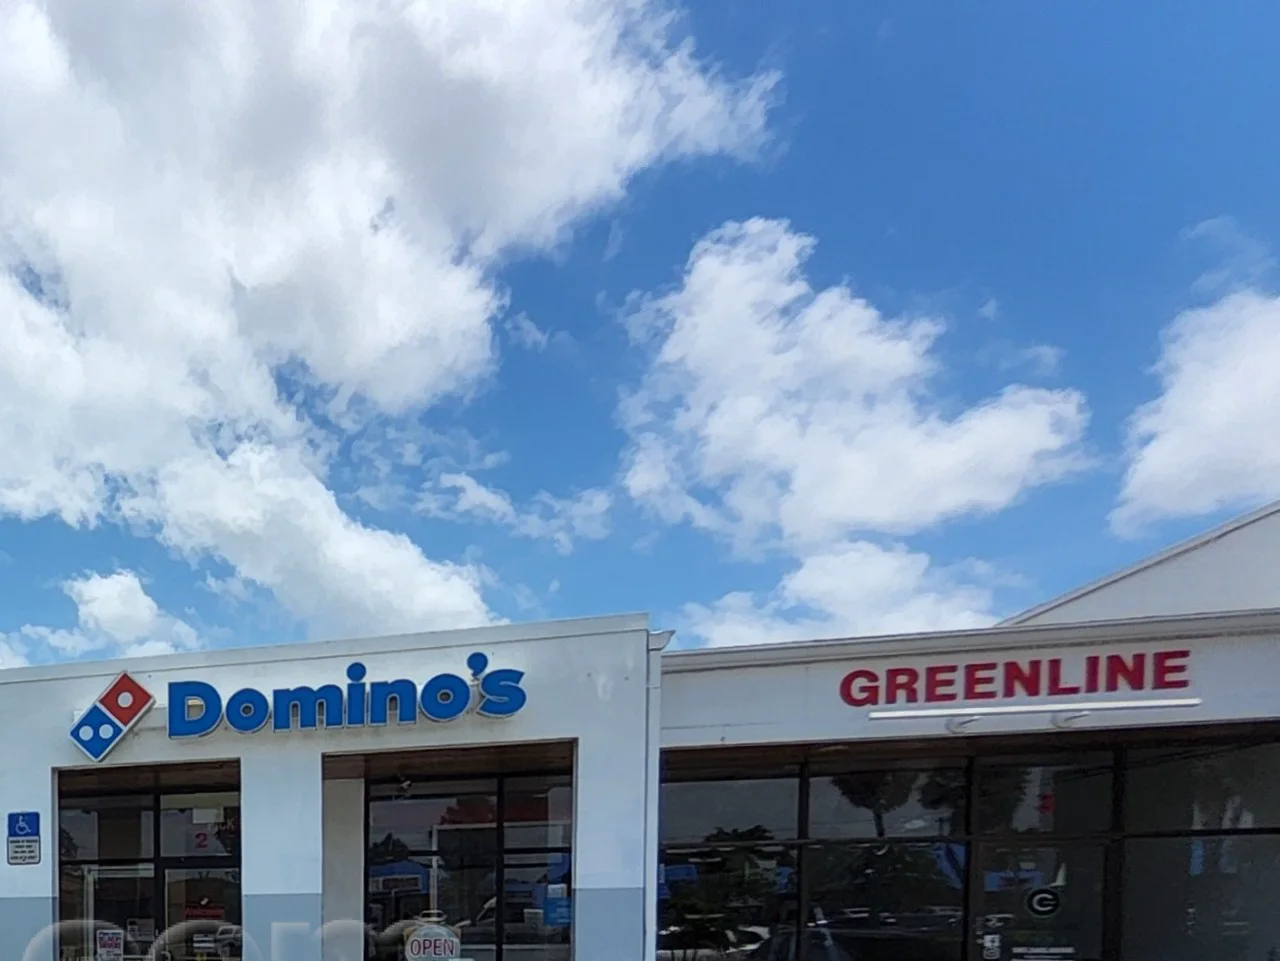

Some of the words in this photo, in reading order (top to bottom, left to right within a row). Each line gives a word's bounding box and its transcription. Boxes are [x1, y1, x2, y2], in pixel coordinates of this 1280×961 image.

[167, 651, 528, 740] Domino's
[839, 649, 1191, 707] GREENLINE
[195, 832, 208, 849] 2
[410, 938, 455, 957] OPEN
